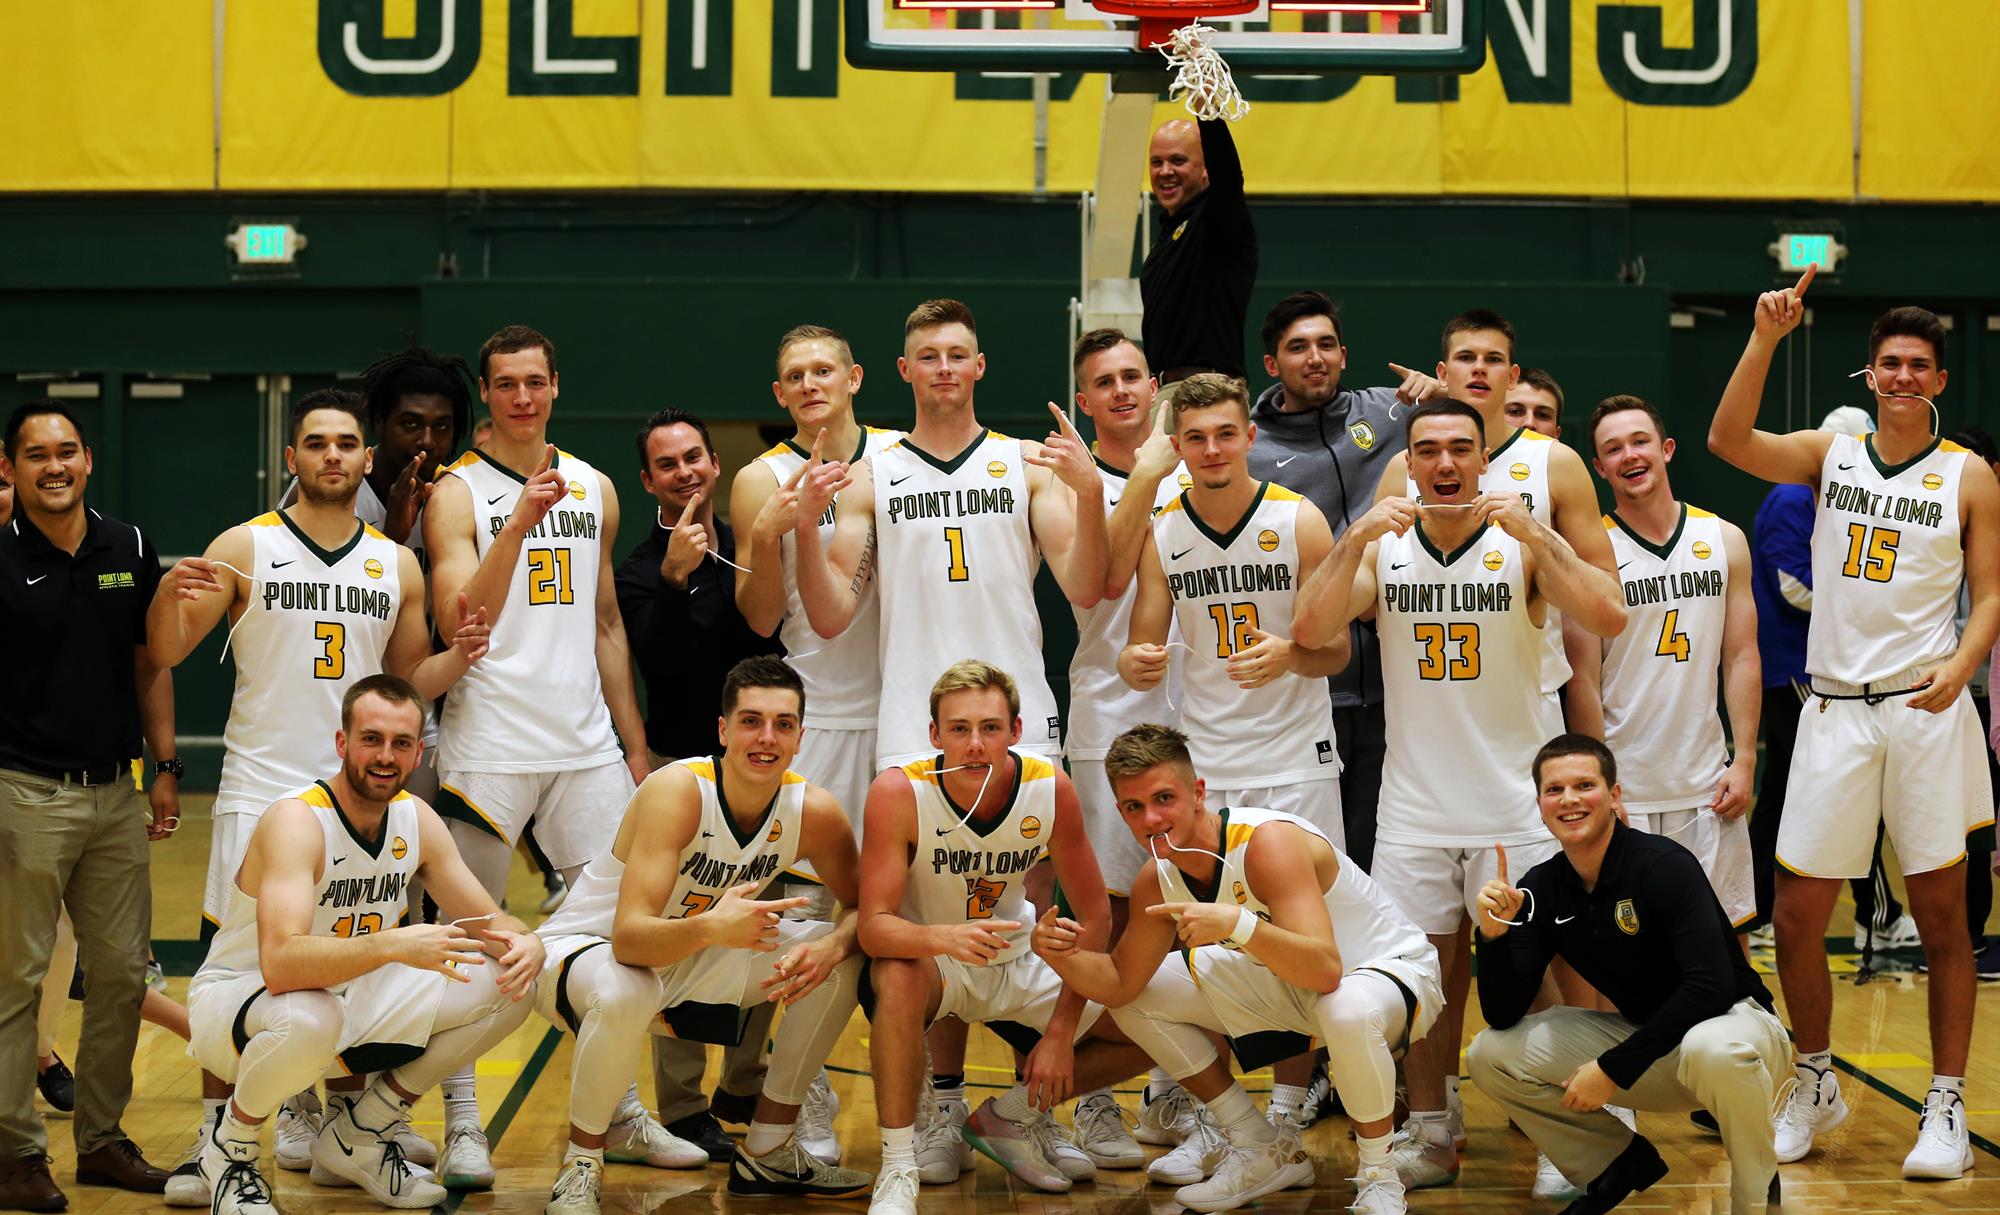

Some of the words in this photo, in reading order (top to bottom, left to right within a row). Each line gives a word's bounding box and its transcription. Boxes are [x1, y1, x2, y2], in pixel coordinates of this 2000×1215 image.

[247, 224, 287, 257] EXIT
[1790, 234, 1829, 267] EXIT
[888, 491, 951, 524] POINT
[956, 487, 1014, 517] LOMA
[1826, 481, 1882, 516] POINT
[1882, 496, 1943, 528] LOMA
[490, 514, 546, 539] PNT
[548, 510, 597, 540] LOMA
[944, 527, 969, 582] 1
[1842, 522, 1901, 583] 15
[528, 548, 574, 606] 21
[1169, 565, 1229, 600] POINT
[1231, 563, 1292, 593] LOMA
[1624, 575, 1667, 607] OINT
[1670, 570, 1723, 600] LOMA
[263, 581, 330, 611] POINT
[335, 584, 391, 620] LOMA
[1385, 583, 1445, 612] POINT
[1450, 582, 1512, 612] LOMA
[313, 620, 346, 680] 3
[1208, 602, 1260, 659] 12
[1655, 608, 1691, 663] 4
[1413, 622, 1481, 681] 33
[931, 848, 983, 875] PONT
